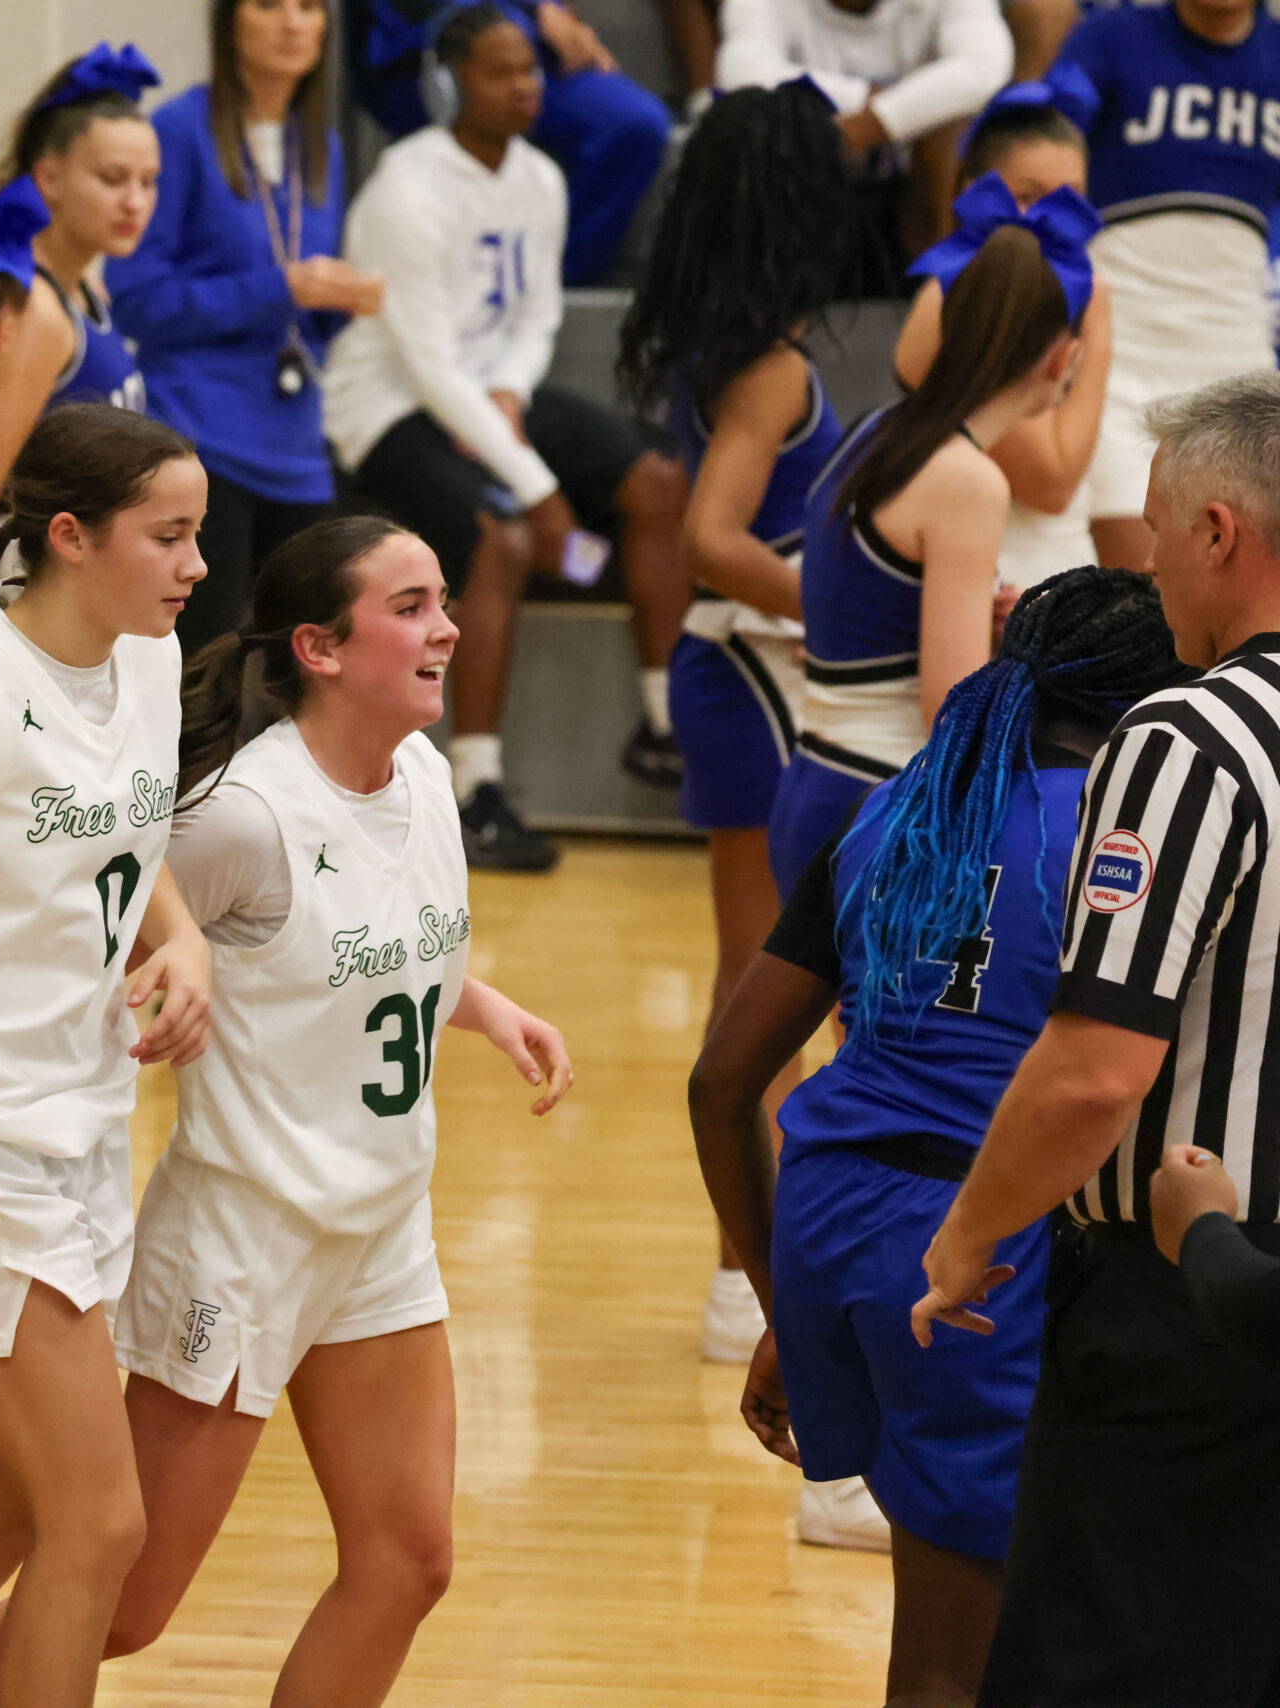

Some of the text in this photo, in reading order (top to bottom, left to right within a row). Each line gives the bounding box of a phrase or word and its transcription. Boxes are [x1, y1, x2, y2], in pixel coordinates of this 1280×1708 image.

[1123, 84, 1280, 160] JCHS
[27, 769, 178, 843] Free Stat
[1095, 864, 1133, 882] KSHSAA
[1102, 842, 1139, 855] REGISTERED
[95, 851, 141, 968] 0
[1093, 890, 1121, 903] OFFICIAL
[329, 924, 407, 987] Free
